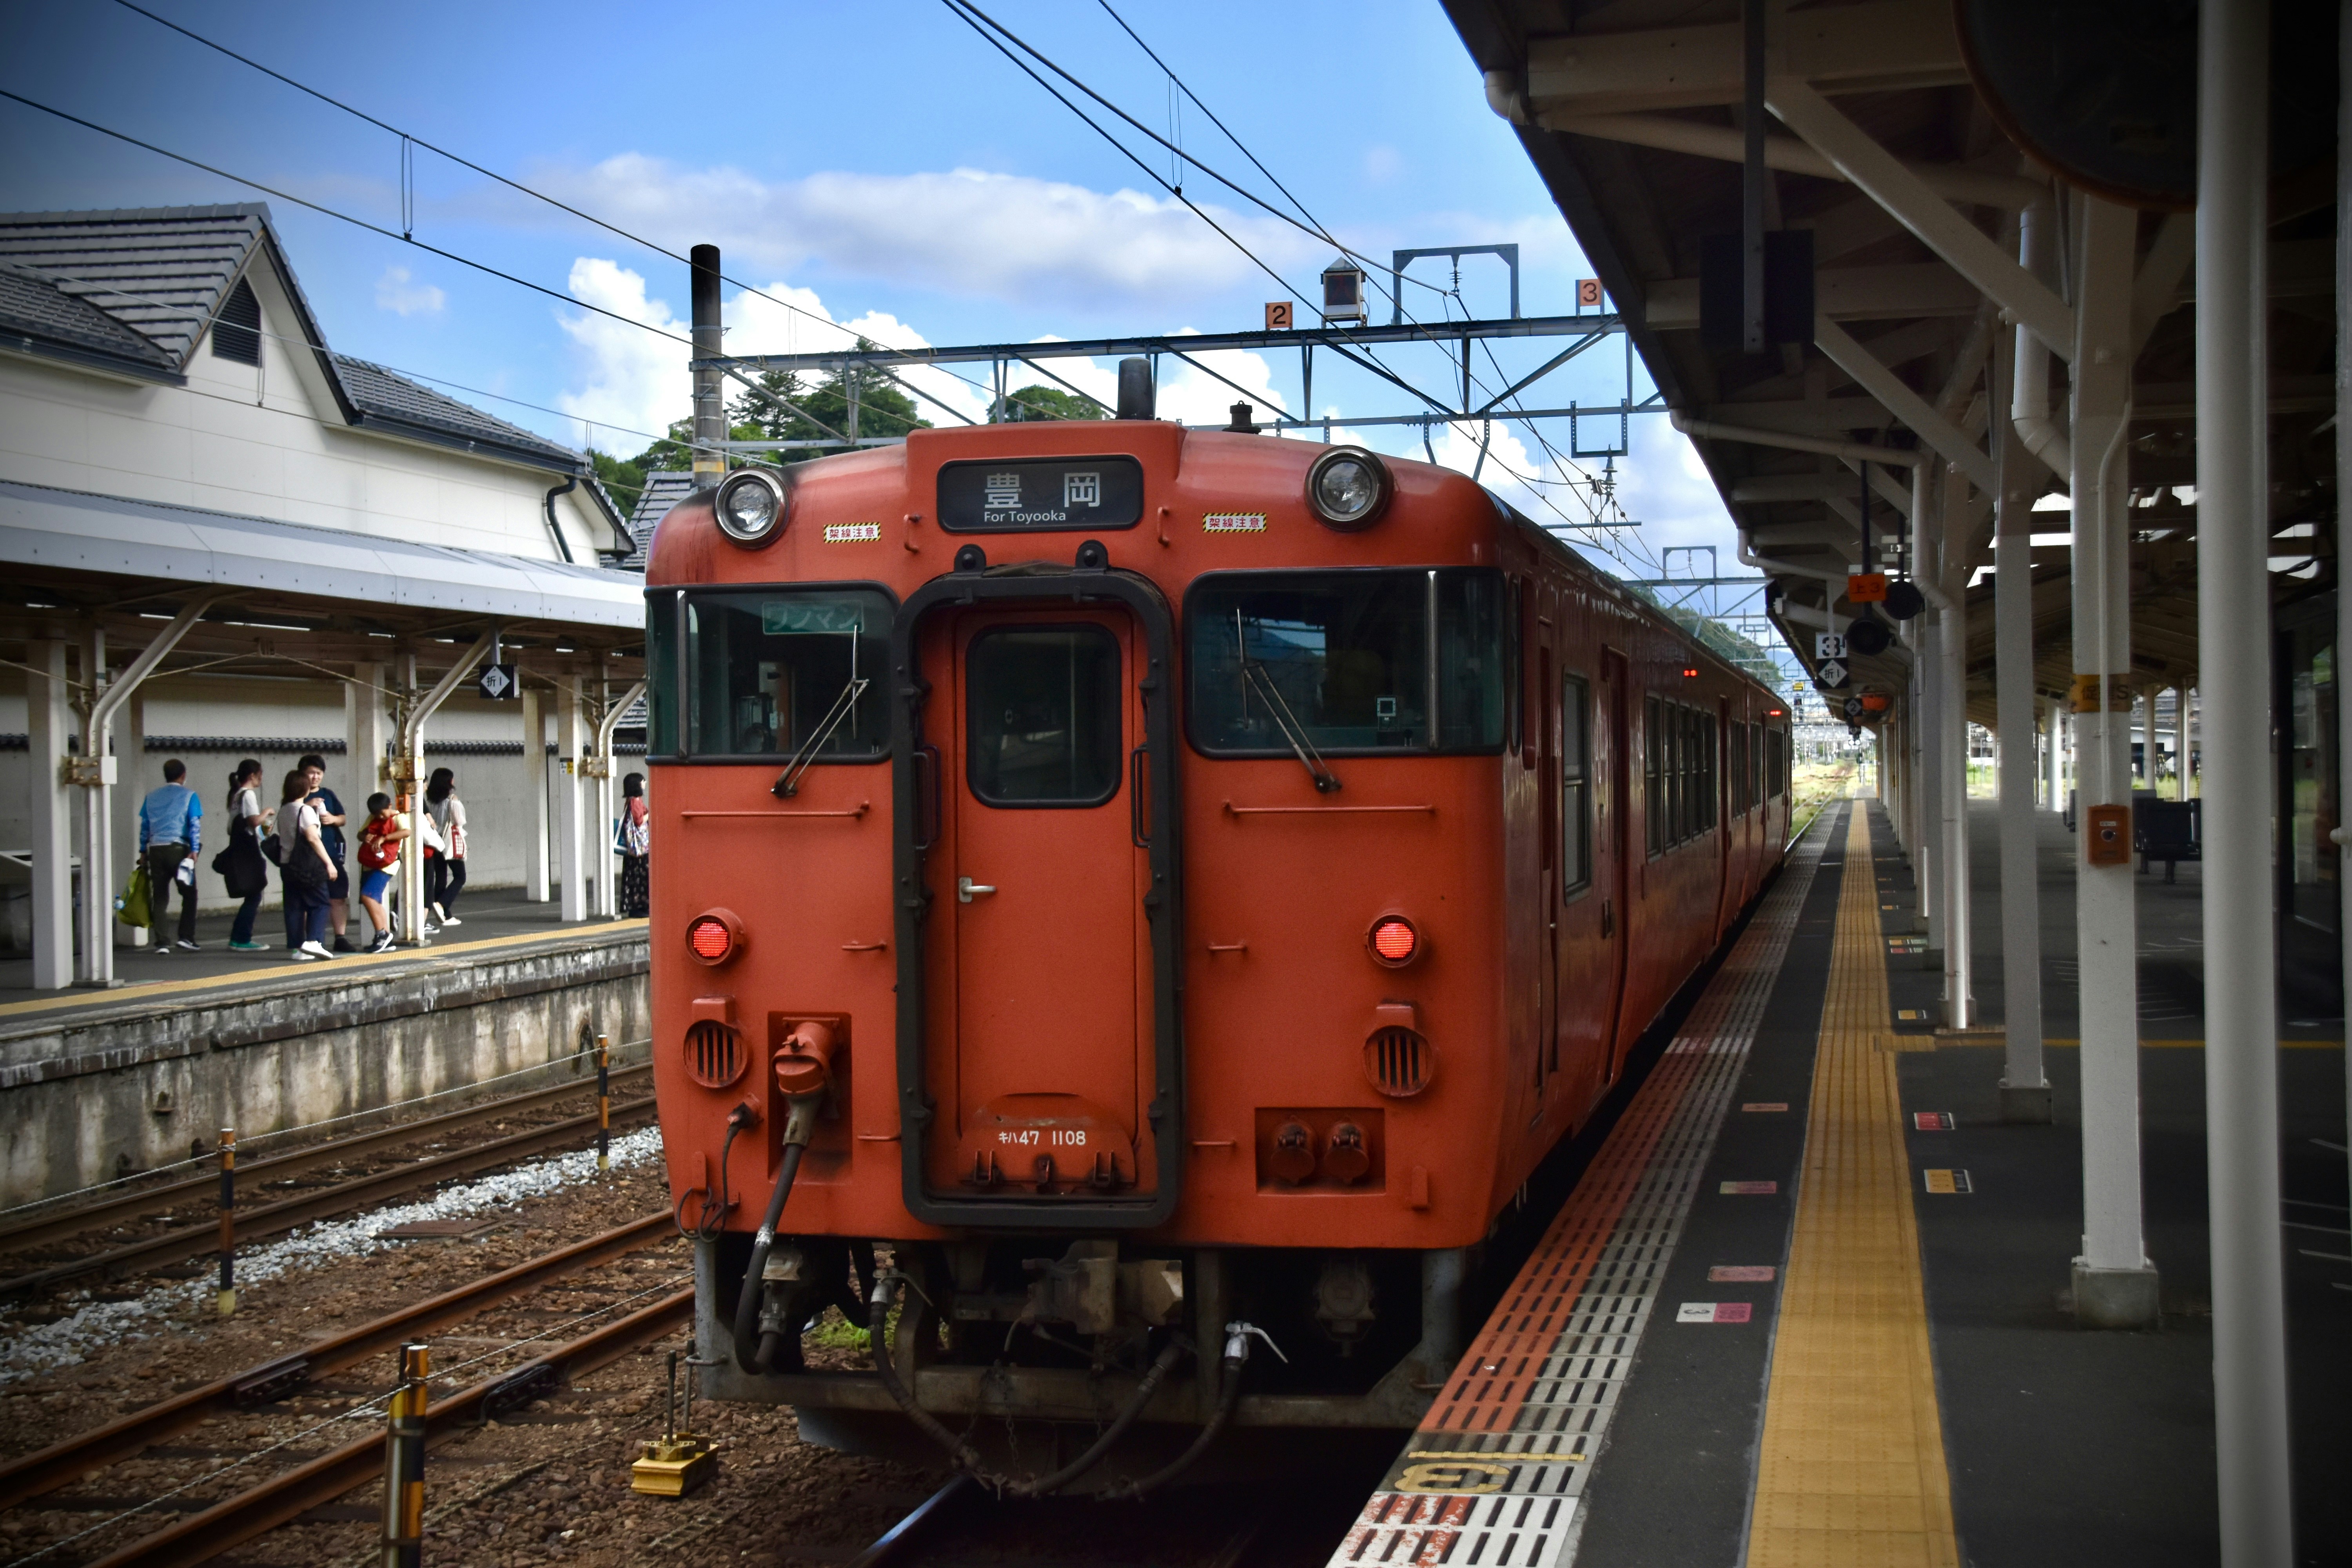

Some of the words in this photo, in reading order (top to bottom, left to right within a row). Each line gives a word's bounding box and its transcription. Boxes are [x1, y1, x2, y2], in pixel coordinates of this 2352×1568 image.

[1583, 282, 1597, 302] 3
[1272, 305, 1286, 325] 2
[984, 512, 1005, 522] For
[1008, 510, 1066, 524] Toyooka
[1209, 517, 1260, 528] 架線注意
[829, 526, 875, 539] 架線注意
[1822, 637, 1840, 656] 3
[1850, 703, 1857, 712] 2
[998, 1130, 1040, 1145] キハ47
[1052, 1130, 1086, 1145] 1108
